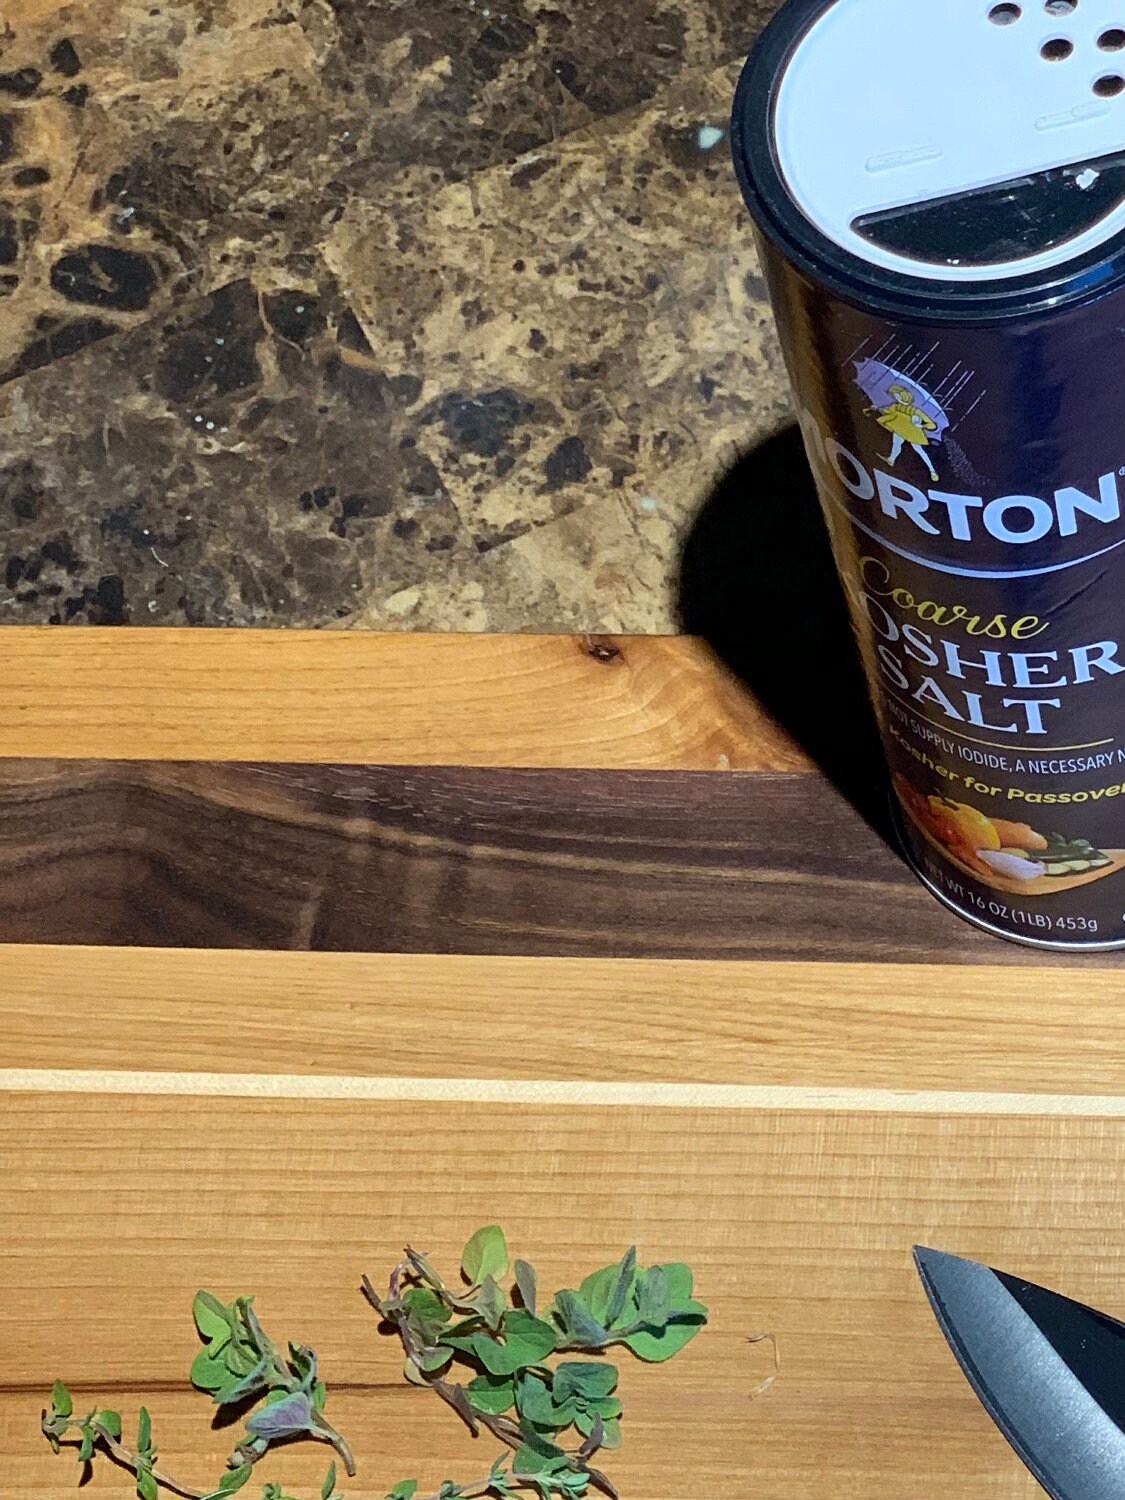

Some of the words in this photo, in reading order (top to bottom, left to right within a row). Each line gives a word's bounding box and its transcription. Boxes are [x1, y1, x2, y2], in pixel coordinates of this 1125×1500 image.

[860, 556, 1050, 640] Coarse
[878, 645, 1060, 734] SALT
[889, 725, 960, 781] Kosher
[964, 776, 1003, 798] for
[911, 719, 955, 754] SUPPLY
[958, 745, 1013, 773] IODIDE,
[1015, 758, 1026, 774] A
[1029, 751, 1114, 775] NECESSARY
[947, 881, 965, 898] WT
[967, 891, 986, 909] 16
[988, 902, 1009, 919] OZ
[1011, 910, 1052, 930] (1LB)
[1056, 916, 1098, 932] 453g
